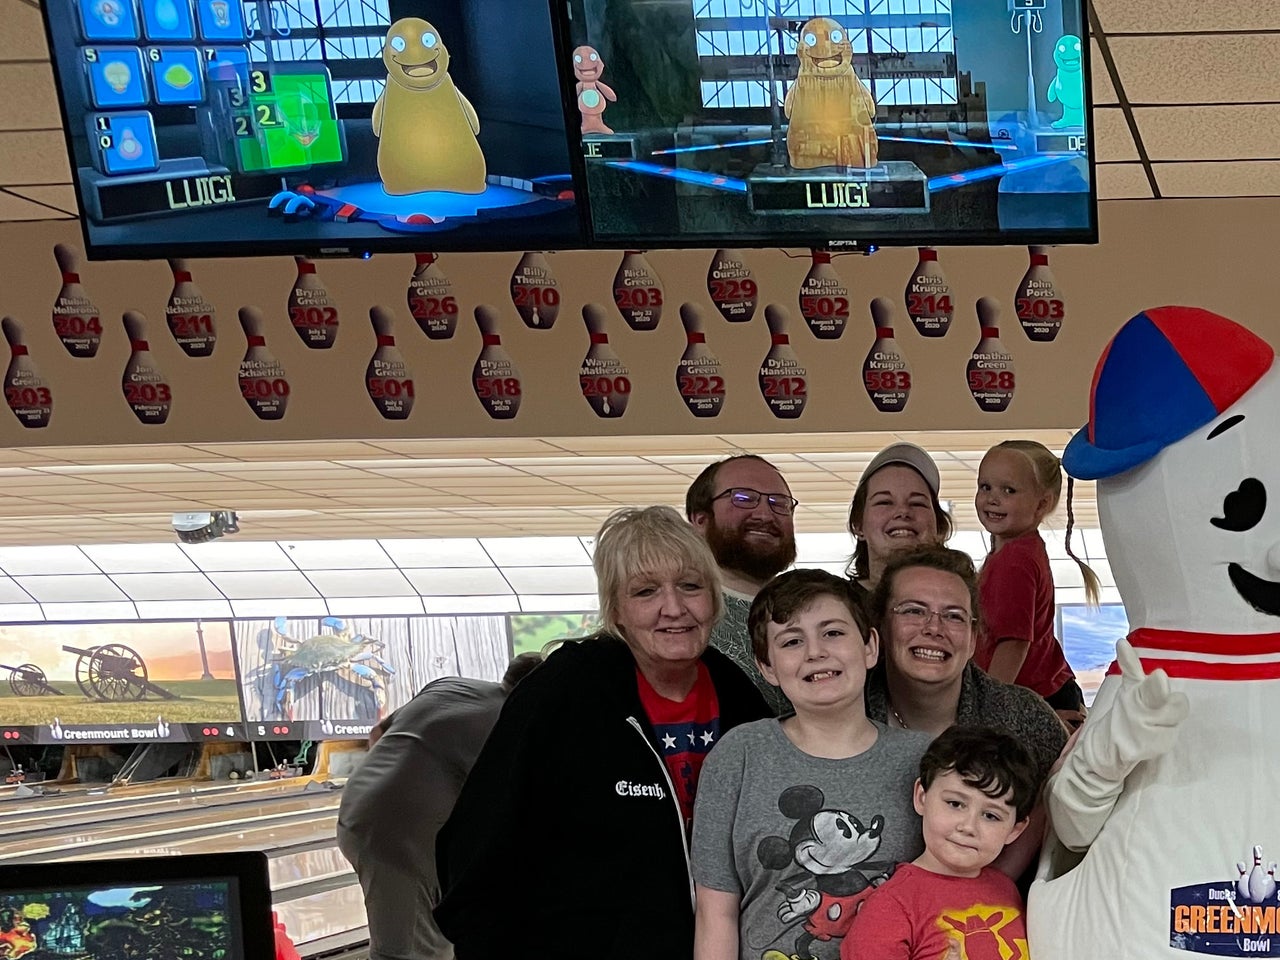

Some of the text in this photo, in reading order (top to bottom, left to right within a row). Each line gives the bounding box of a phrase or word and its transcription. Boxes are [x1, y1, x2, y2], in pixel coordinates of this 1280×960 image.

[85, 51, 97, 62] 5
[206, 50, 214, 60] 7
[166, 174, 236, 209] LUIGI
[806, 182, 871, 208] LUIGI
[719, 261, 741, 270] Jake
[523, 267, 546, 277] Billy
[624, 270, 647, 278] Nick
[713, 270, 750, 278] Oursler
[515, 276, 556, 285] Thomas
[624, 278, 653, 286] Green
[809, 279, 838, 288] Dylan
[917, 276, 942, 284] Chris
[1027, 280, 1052, 289] John
[295, 288, 325, 299] Bryan
[417, 287, 446, 296] Green
[711, 279, 758, 300] 229
[802, 287, 847, 295] Hanshew
[912, 284, 948, 294] Kruger
[1027, 289, 1054, 297] Ports
[297, 297, 327, 306] Green
[514, 287, 560, 306] 210
[616, 288, 663, 308] 203
[412, 297, 459, 318] 226
[803, 297, 849, 317] 502
[909, 295, 953, 314] 214
[1017, 300, 1064, 318] 203
[292, 307, 339, 327] 202
[55, 315, 103, 335] 204
[173, 315, 215, 335] 211
[874, 353, 899, 361] Chris
[241, 360, 280, 368] Michael
[374, 360, 404, 369] Bryan
[480, 360, 510, 369] Bryan
[585, 359, 620, 368] Wayne
[768, 359, 797, 368] Dylan
[870, 361, 905, 370] Kruger
[977, 361, 1006, 369] Green
[375, 368, 405, 377] Green
[482, 368, 511, 377] Green
[580, 367, 629, 375] Matheson
[688, 366, 717, 374] Green
[761, 367, 806, 375] Hanshew
[12, 378, 41, 386] Green
[131, 374, 160, 382] Green
[866, 371, 911, 391] 583
[969, 371, 1015, 390] 528
[241, 379, 290, 398] 200
[370, 379, 414, 398] 501
[477, 378, 521, 398] 518
[582, 377, 631, 396] 200
[681, 376, 725, 395] 222
[764, 377, 807, 396] 212
[7, 387, 52, 407] 203
[125, 383, 172, 402] 203
[64, 727, 158, 740] Greenmount Bowl
[225, 726, 234, 736] 4
[258, 726, 266, 736] 5
[1209, 888, 1236, 900] Ducks
[1243, 938, 1270, 951] Bowl
